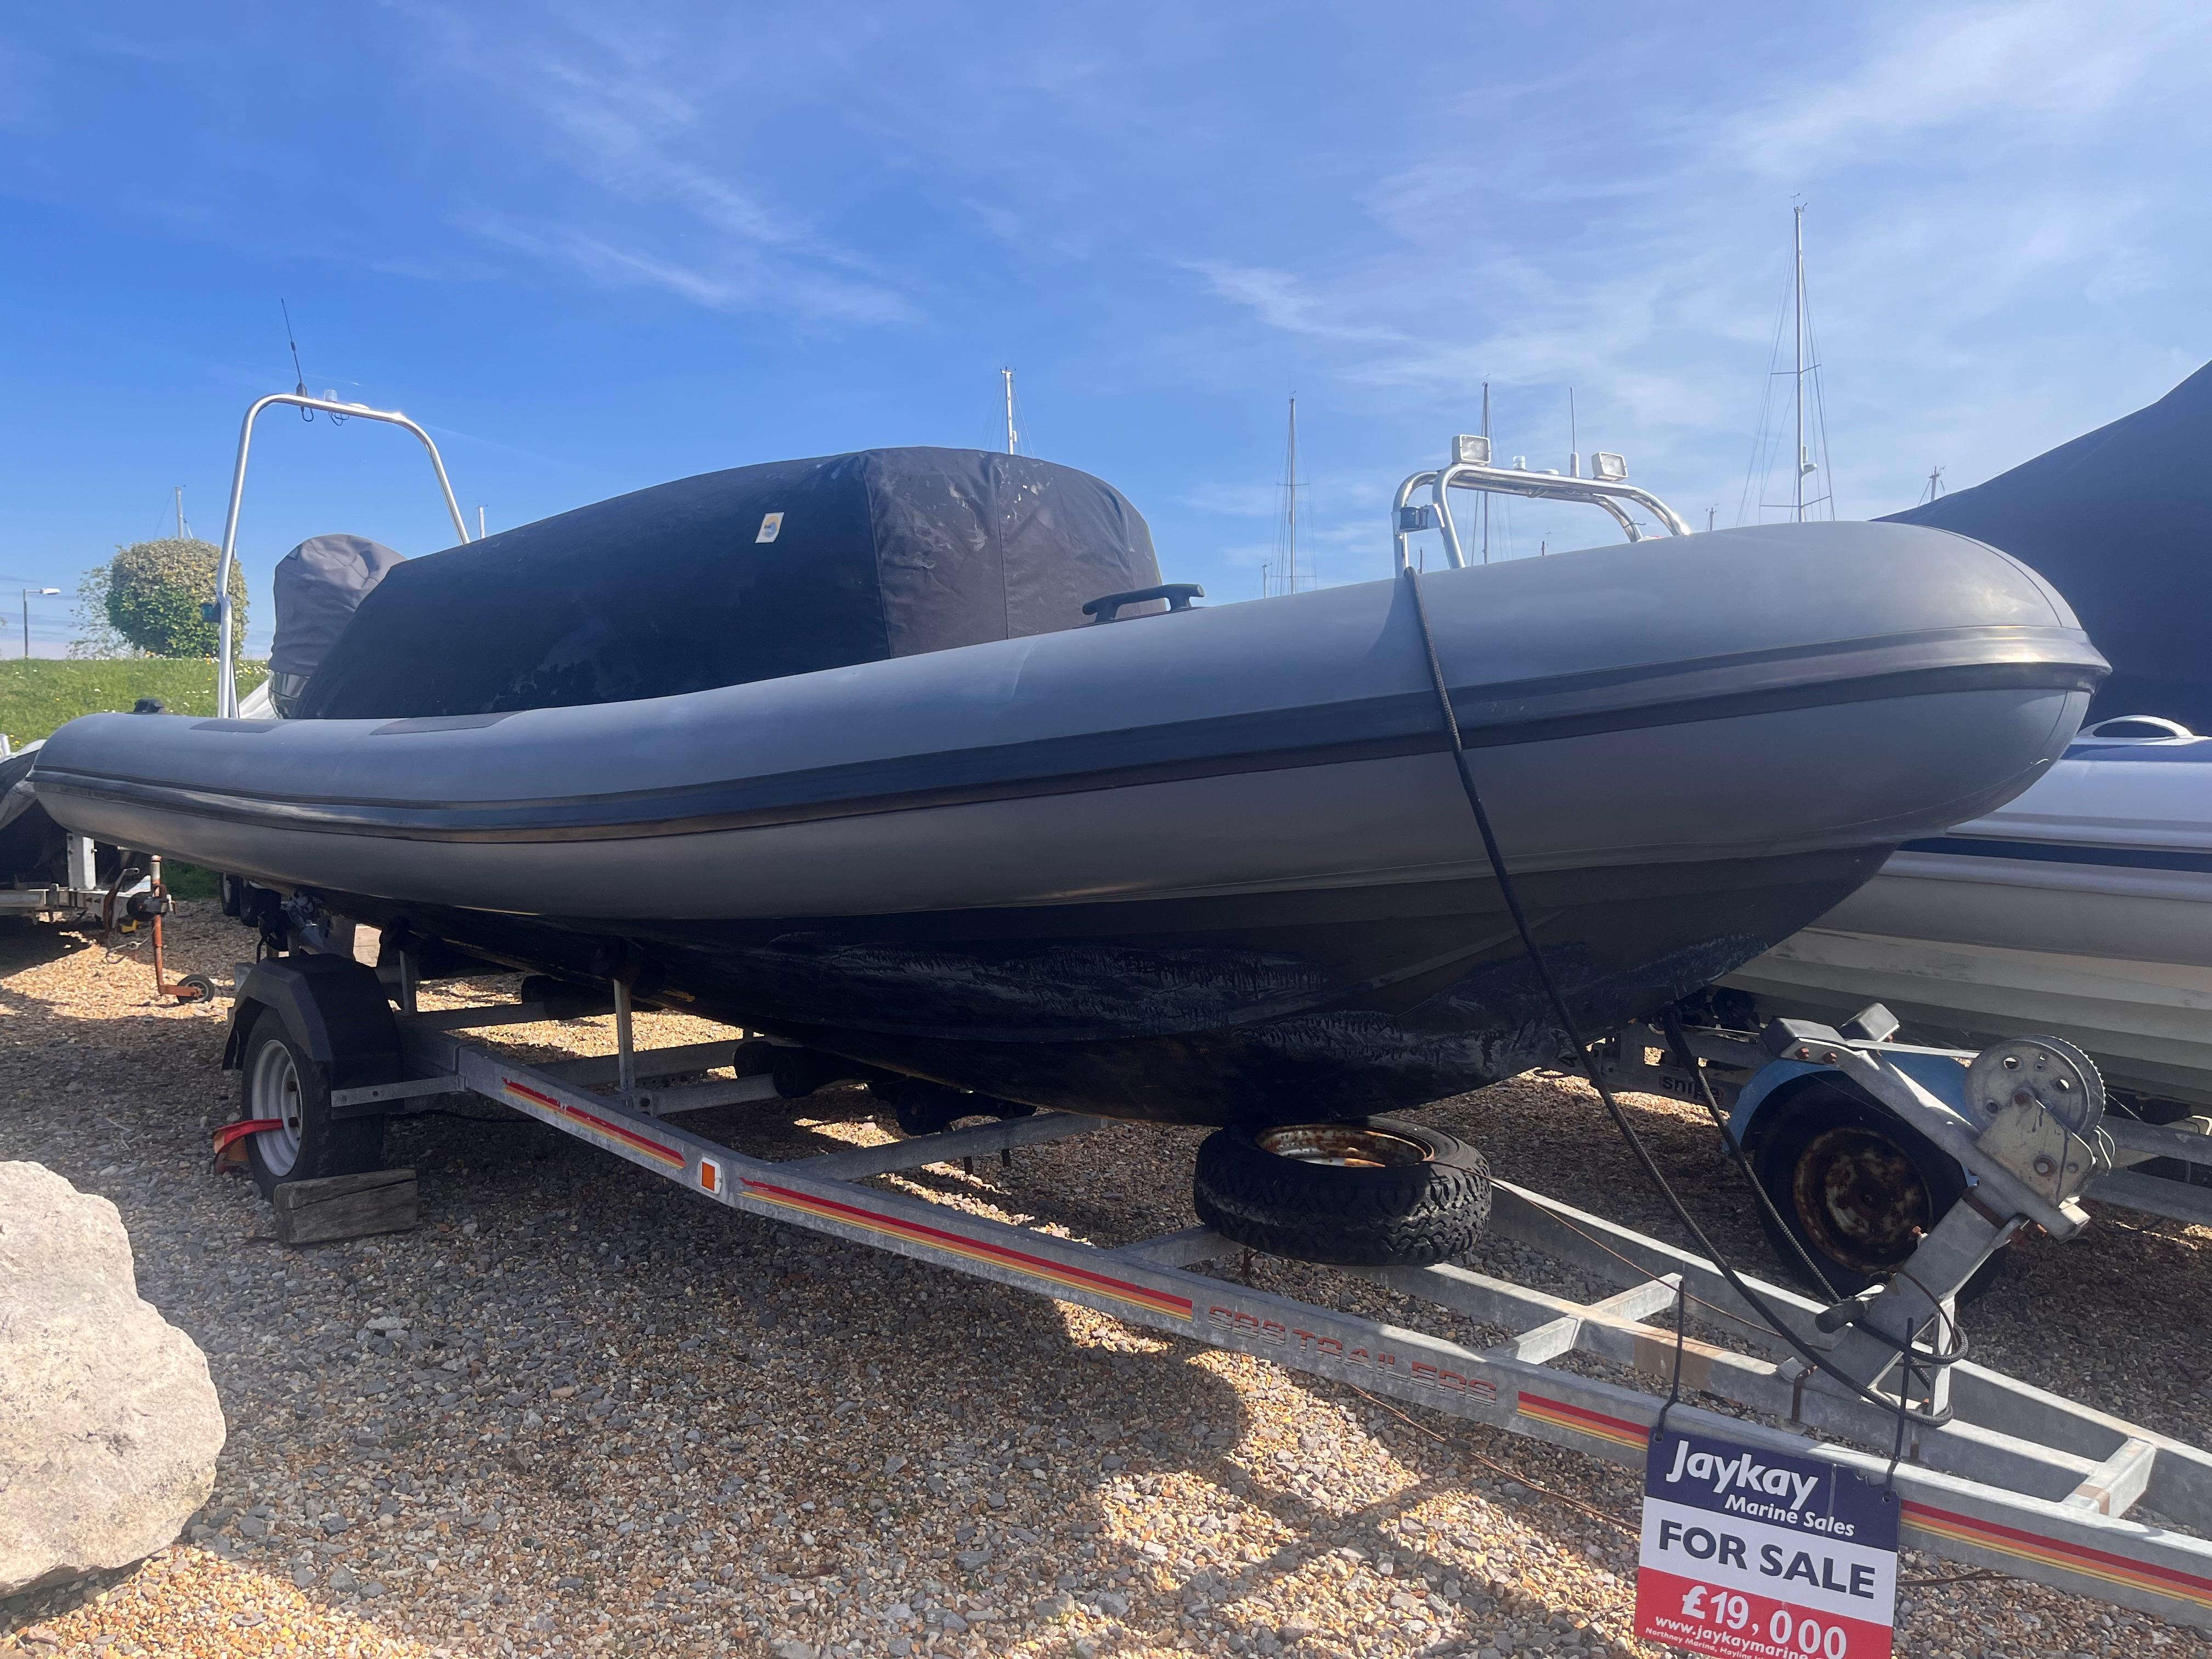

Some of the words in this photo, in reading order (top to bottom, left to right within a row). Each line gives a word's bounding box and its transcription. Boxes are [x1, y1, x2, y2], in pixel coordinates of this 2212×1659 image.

[1208, 1305, 1286, 1346] SBS
[1293, 1328, 1497, 1406] TRAILERS
[1666, 1440, 1819, 1510] Jaykay
[1725, 1494, 1798, 1524] Marine
[1803, 1511, 1855, 1537] Sales
[1658, 1519, 1748, 1571] FOR
[1759, 1544, 1876, 1600] SALE
[1645, 1627, 1683, 1643] Northney
[1685, 1637, 1717, 1652] Marina,
[1656, 1616, 1823, 1659] www.jaykaymarine
